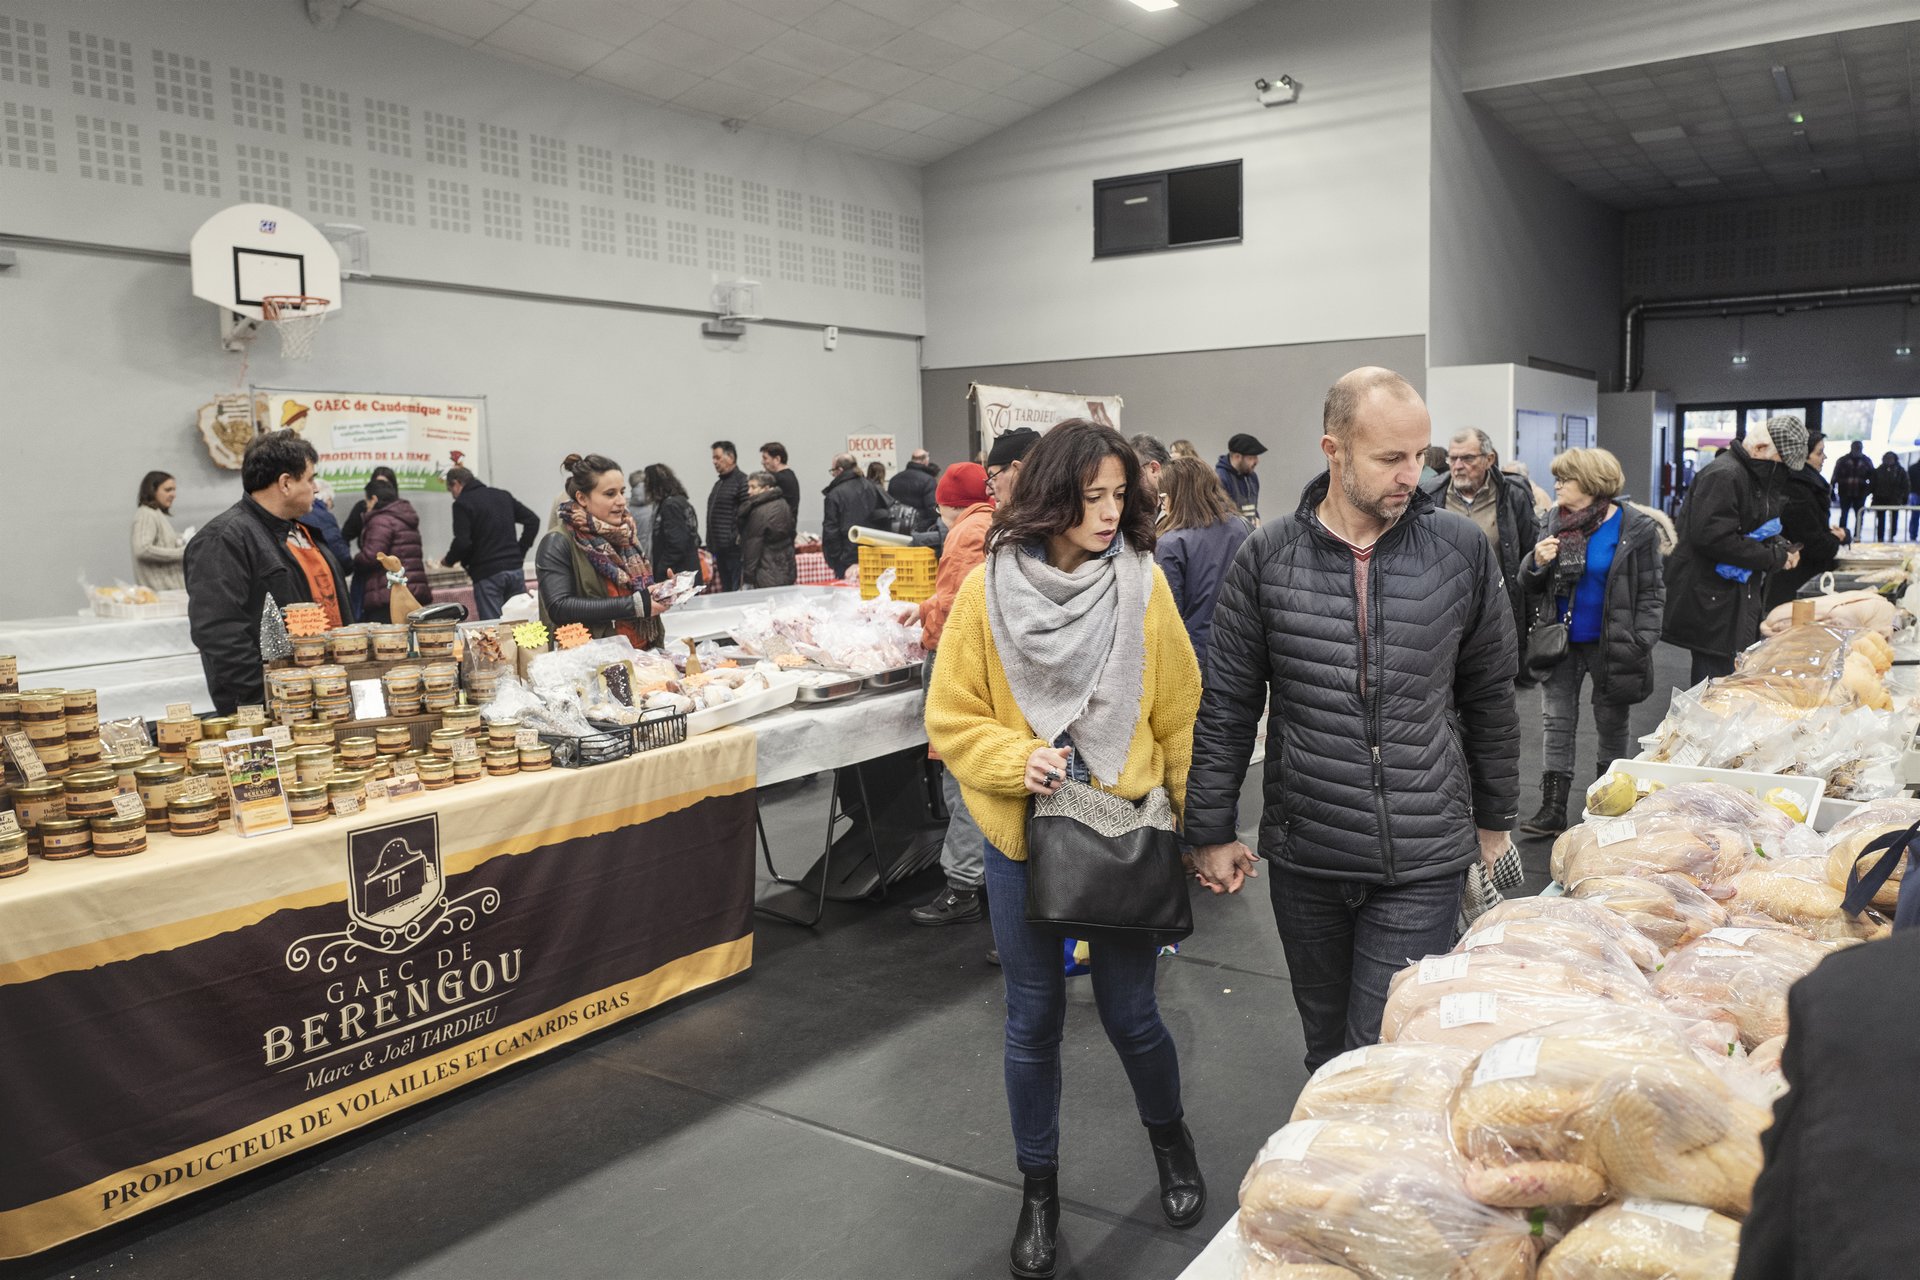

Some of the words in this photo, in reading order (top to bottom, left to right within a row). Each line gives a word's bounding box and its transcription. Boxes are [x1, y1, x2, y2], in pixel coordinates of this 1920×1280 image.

[314, 399, 350, 412] GAEC
[354, 400, 368, 411] de
[1015, 408, 1055, 422] TARDIEU
[320, 451, 372, 462] PRODUITS
[375, 452, 387, 460] DE
[391, 452, 403, 460] LA
[849, 438, 894, 451] DECOUPE
[326, 960, 414, 1004] GAEC
[437, 941, 472, 969] DE
[262, 948, 523, 1066] BERENGOU
[304, 1062, 354, 1092] Marc
[359, 1051, 375, 1071] &
[379, 1036, 416, 1064] Joël
[421, 1006, 499, 1047] TARDIEU
[101, 1123, 295, 1211] PRODUCTEUR
[300, 1107, 332, 1136] DE
[336, 1059, 460, 1118] VOLAILLES
[465, 1045, 490, 1070] ET
[495, 1010, 579, 1056] CANARDS
[583, 991, 630, 1020] GRAS
